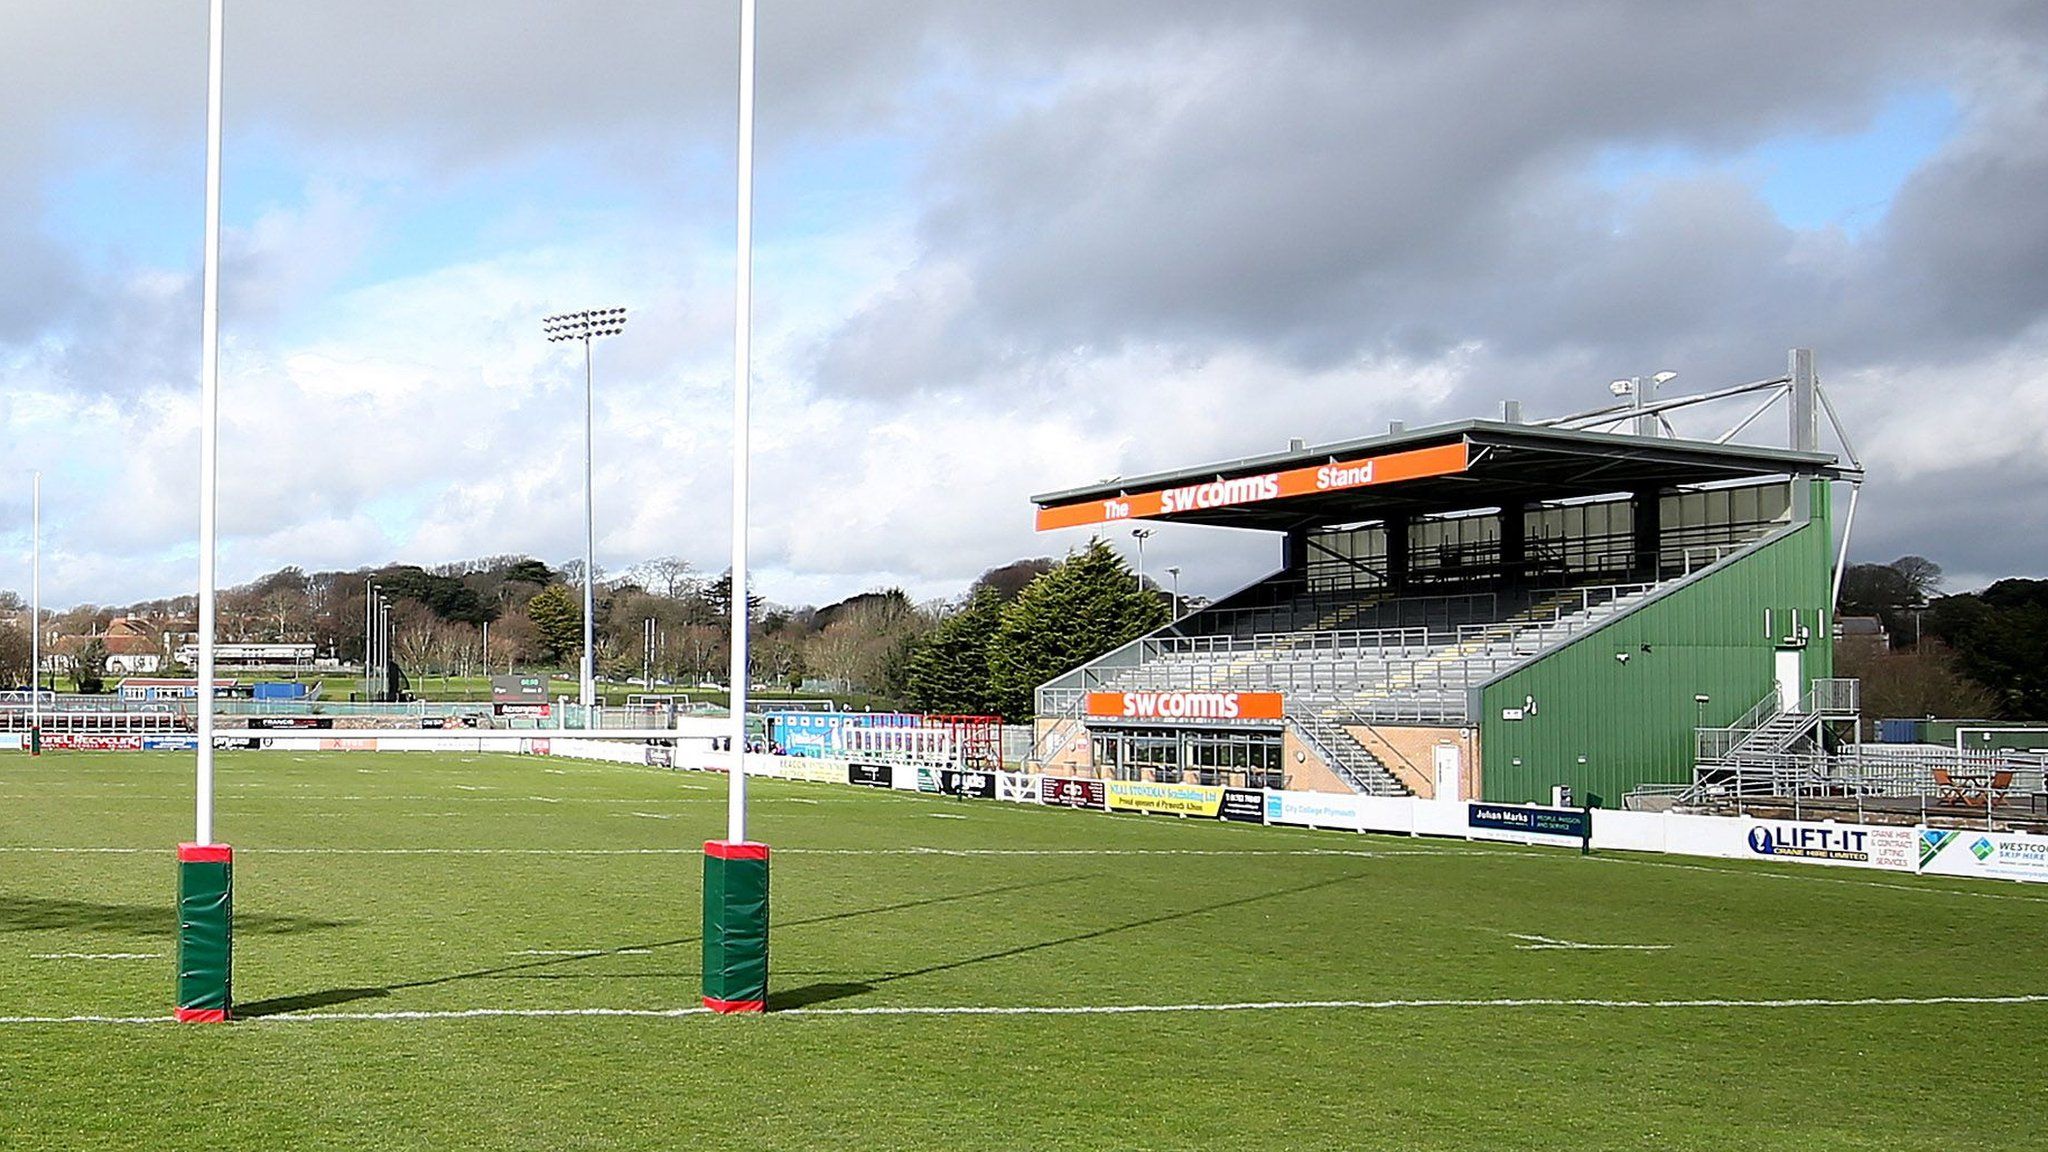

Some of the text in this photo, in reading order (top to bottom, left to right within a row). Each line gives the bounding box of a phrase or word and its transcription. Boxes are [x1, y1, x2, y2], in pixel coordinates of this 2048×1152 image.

[1103, 461, 1373, 518] The swcomms Stand
[1122, 692, 1239, 718] swcomms
[1476, 809, 1528, 822] Julian Marks
[1776, 827, 1868, 851] LIFT-IT
[1871, 829, 1911, 839] CRANE HIRE
[1877, 840, 1913, 848] CONTRACT
[1999, 842, 2048, 853] WESTCO
[1773, 847, 1867, 861] CRANE HIRE LIMITED
[1879, 849, 1905, 857] LIFTING
[2000, 851, 2045, 861] SKIP HIRE
[1876, 857, 1908, 866] SERVICES
